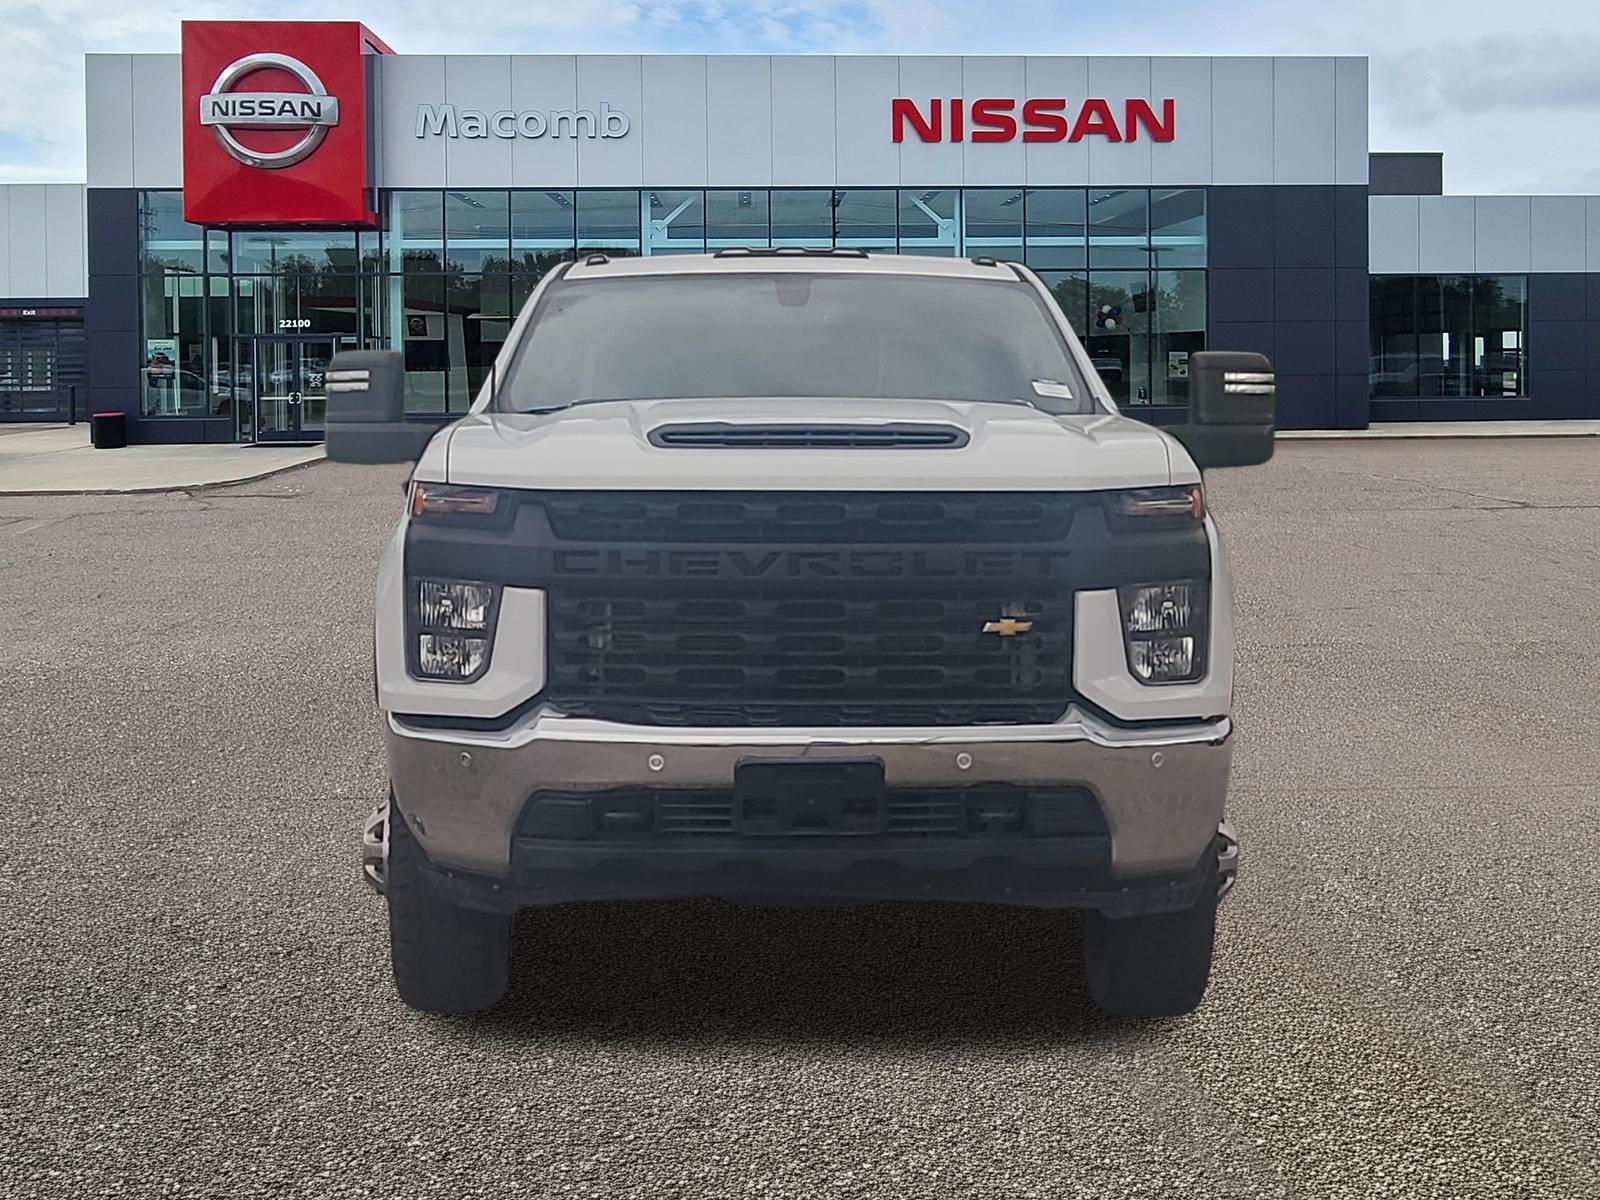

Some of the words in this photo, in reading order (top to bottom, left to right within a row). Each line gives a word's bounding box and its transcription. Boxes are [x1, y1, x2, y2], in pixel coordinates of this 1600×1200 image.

[212, 100, 322, 118] NISSAN
[415, 102, 630, 139] Macomb
[892, 98, 1176, 143] NISSAN
[279, 319, 312, 328] 22100
[552, 550, 1070, 577] CHEVROLET
